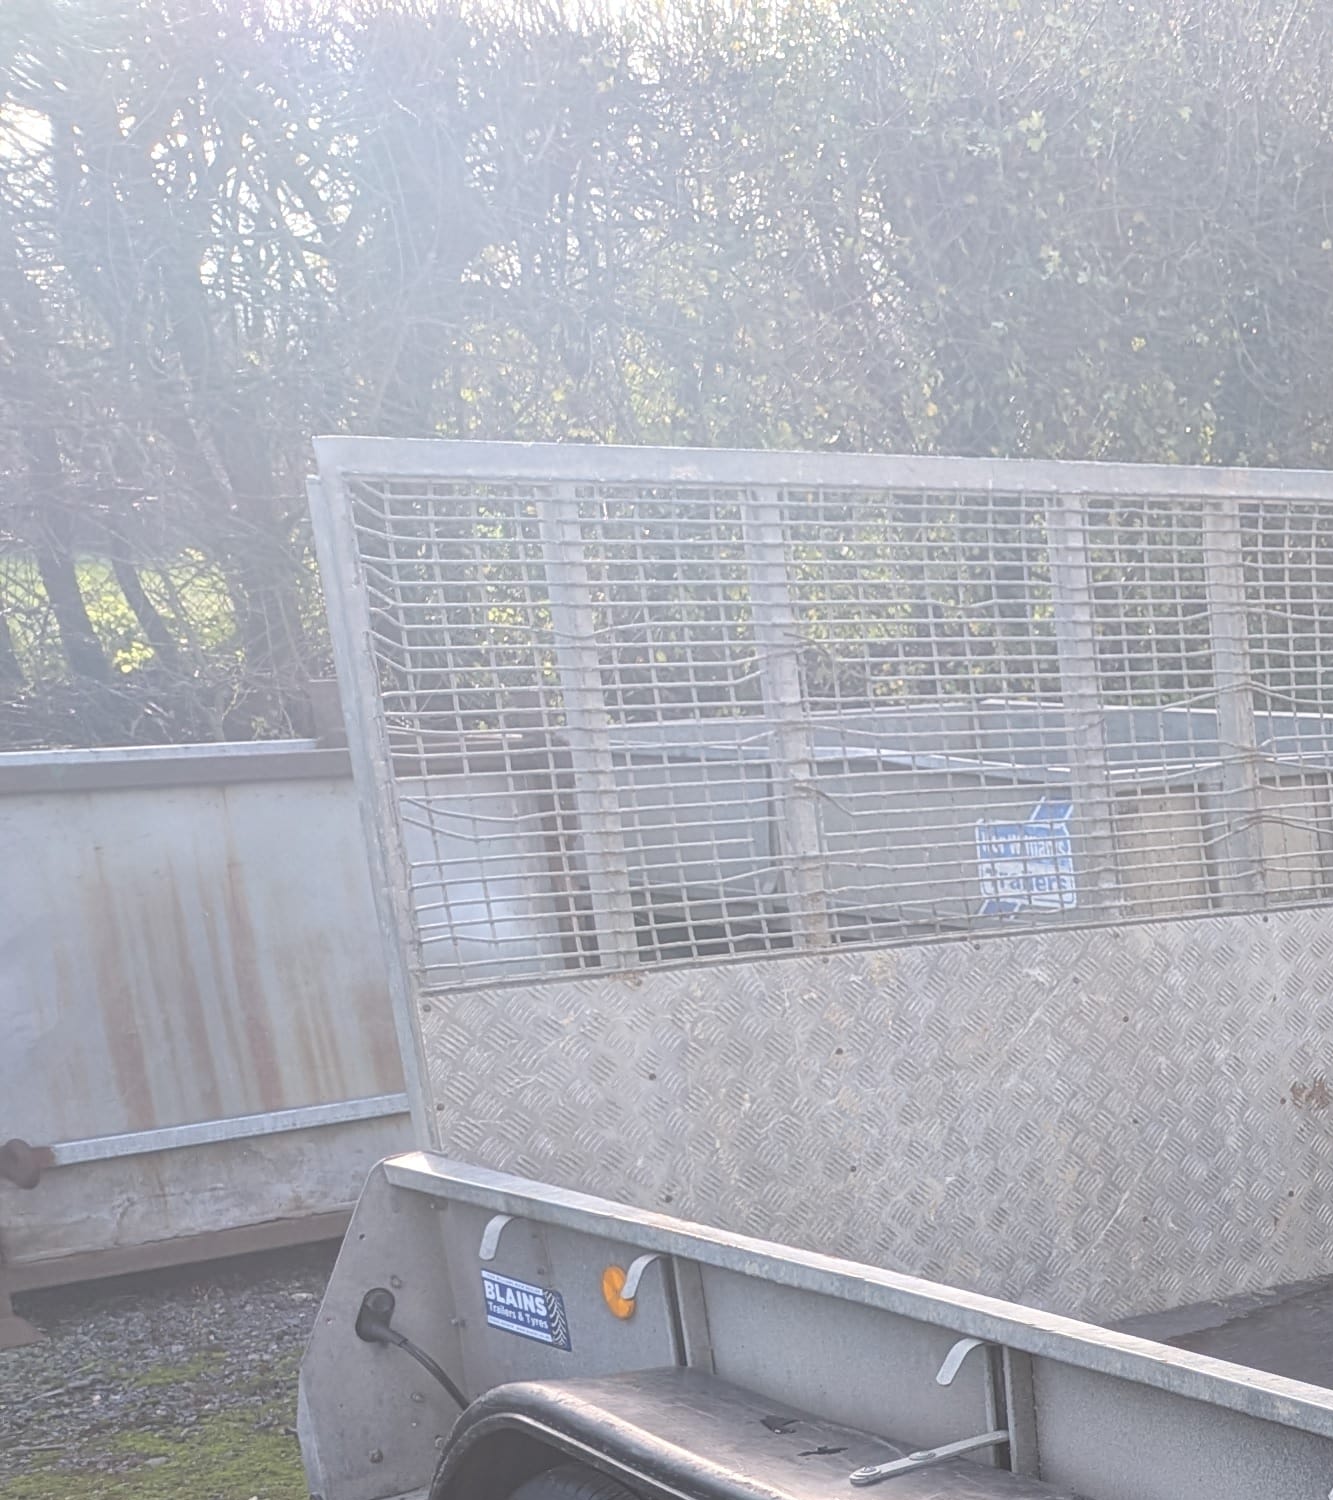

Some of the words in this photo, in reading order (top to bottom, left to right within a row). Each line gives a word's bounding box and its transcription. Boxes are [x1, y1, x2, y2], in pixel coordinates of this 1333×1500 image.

[484, 1280, 547, 1317] BLAINS
[488, 1301, 516, 1320] Trailers
[518, 1311, 525, 1322] &
[525, 1316, 549, 1329] Tyres
